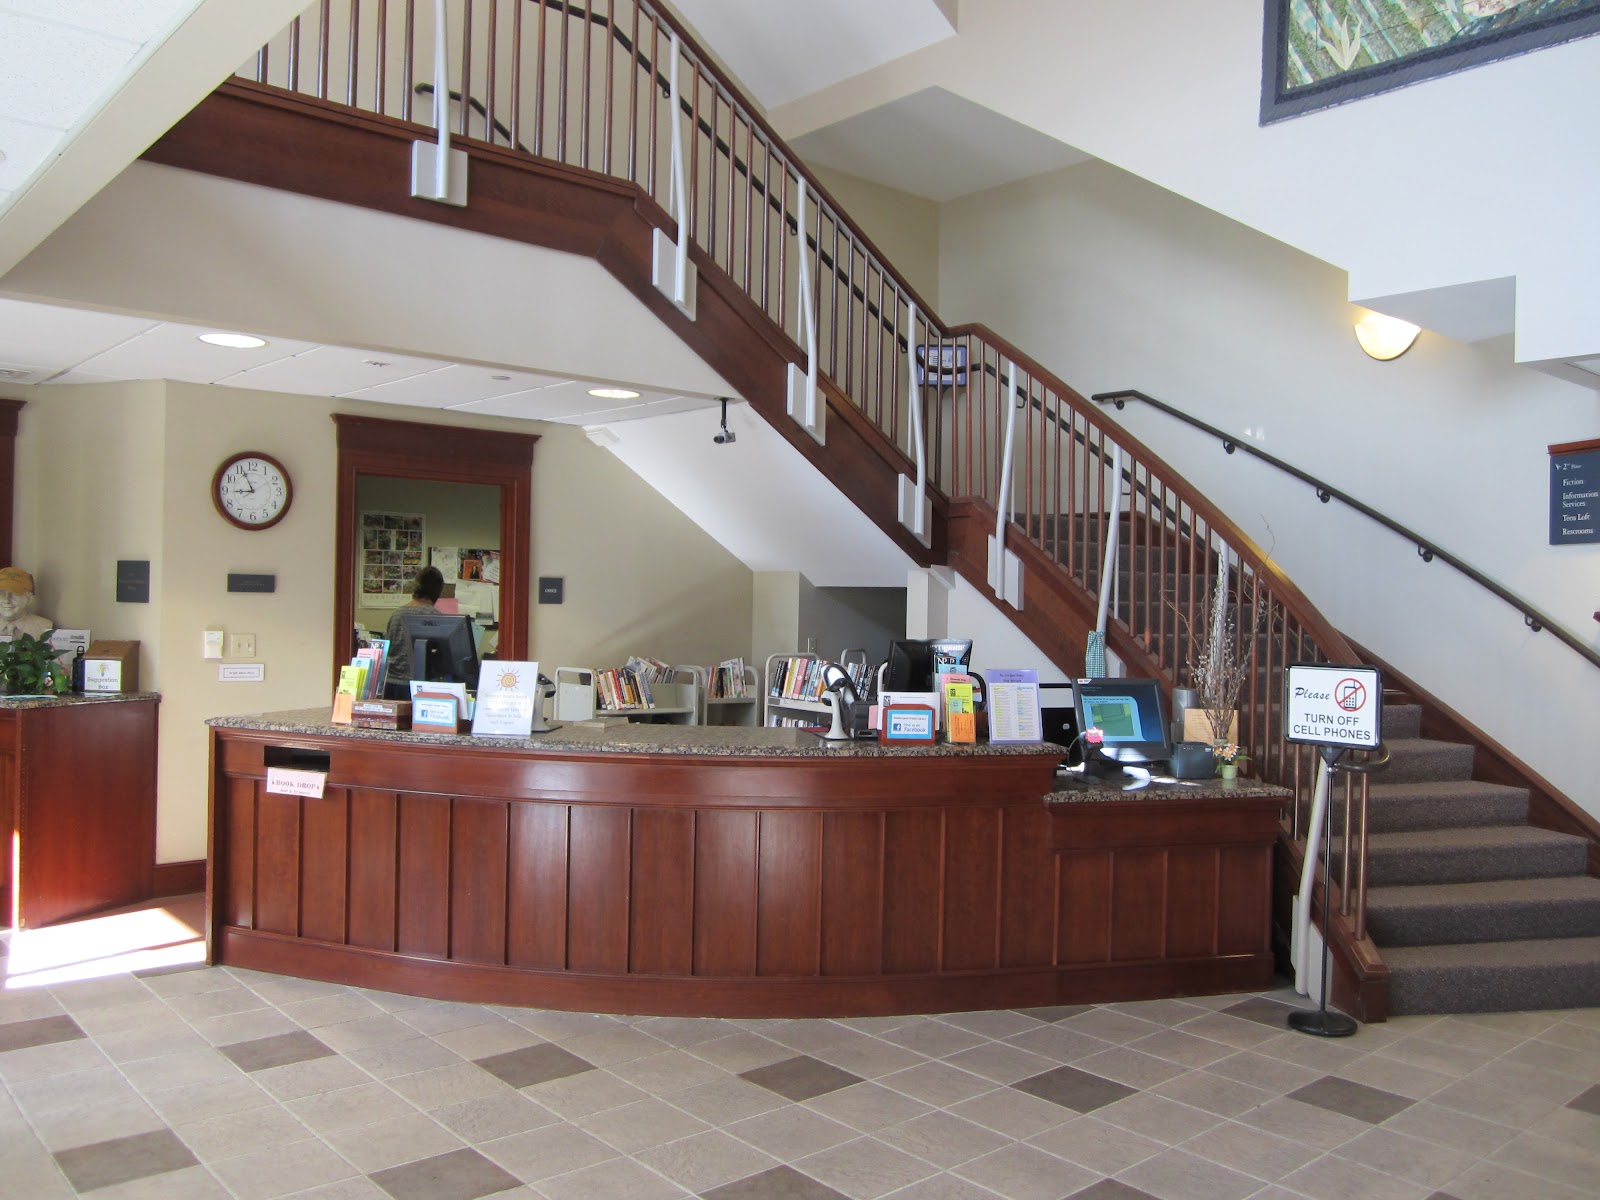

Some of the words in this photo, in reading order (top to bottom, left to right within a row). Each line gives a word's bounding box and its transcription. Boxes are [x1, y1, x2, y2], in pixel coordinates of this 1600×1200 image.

[236, 465, 243, 474] 11
[248, 461, 258, 471] 12
[263, 466, 267, 476] 1
[227, 475, 236, 484] 10
[272, 476, 278, 485] 2
[1563, 478, 1584, 487] Fiction
[222, 486, 228, 495] 9
[276, 487, 282, 496] 3
[1563, 490, 1599, 500] Information
[227, 499, 233, 508] 8
[271, 500, 277, 510] 4
[1563, 499, 1586, 508] Services
[237, 508, 243, 518] 7
[250, 512, 257, 521] 6
[263, 509, 269, 518] 5
[1563, 514, 1577, 522] Teen
[1577, 512, 1590, 521] Loft
[1563, 527, 1594, 536] Restrooms
[1294, 687, 1331, 700] Please
[1304, 713, 1334, 725] TURN
[1337, 716, 1360, 726] OFF
[1293, 724, 1321, 736] CELL
[1324, 727, 1371, 741] PHONES
